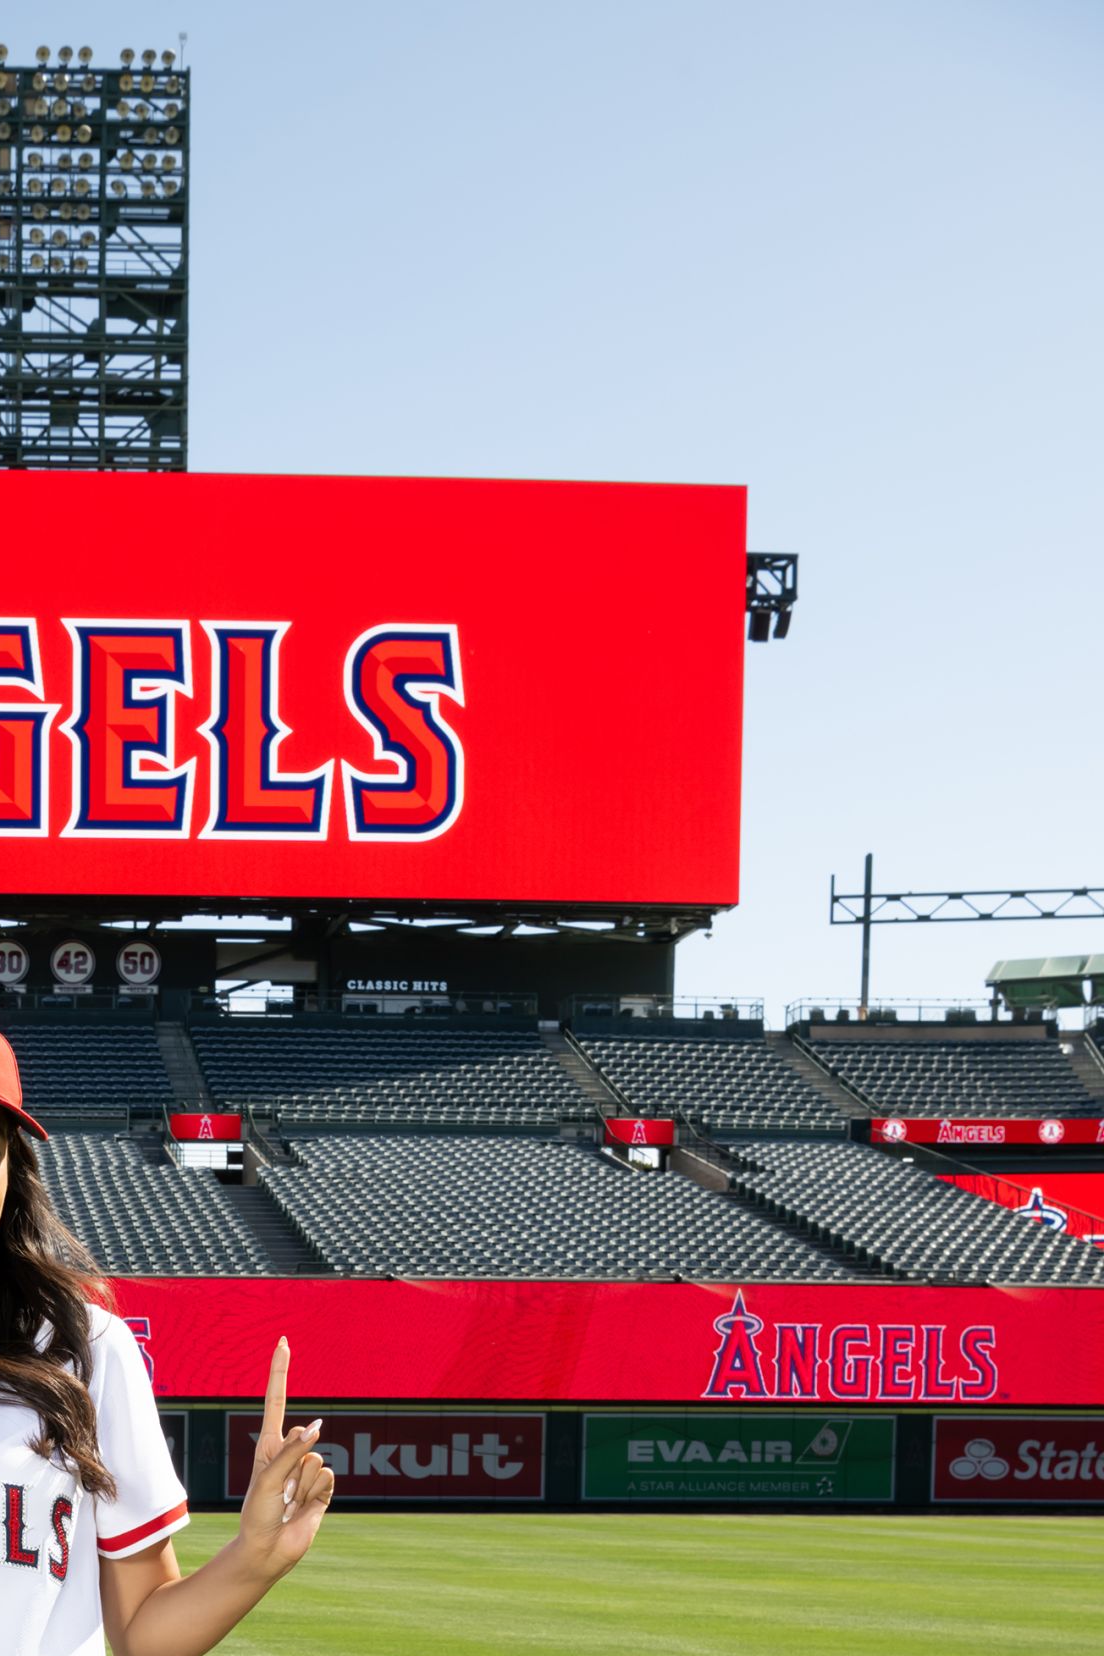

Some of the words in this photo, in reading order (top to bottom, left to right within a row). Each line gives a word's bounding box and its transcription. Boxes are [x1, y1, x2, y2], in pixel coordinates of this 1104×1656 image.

[56, 951, 89, 975] 42
[123, 951, 156, 975] 50
[347, 980, 409, 990] CLASSIC
[412, 981, 447, 991] HITS
[199, 1114, 214, 1138] A
[631, 1119, 646, 1143] A
[937, 1119, 1006, 1144] ANGELS
[700, 1288, 998, 1400] ANGELS
[248, 1433, 524, 1480] akult
[627, 1481, 636, 1492] A
[639, 1481, 674, 1492] STAR
[678, 1482, 745, 1493] ALLIANCE
[750, 1482, 809, 1493] MEMBER
